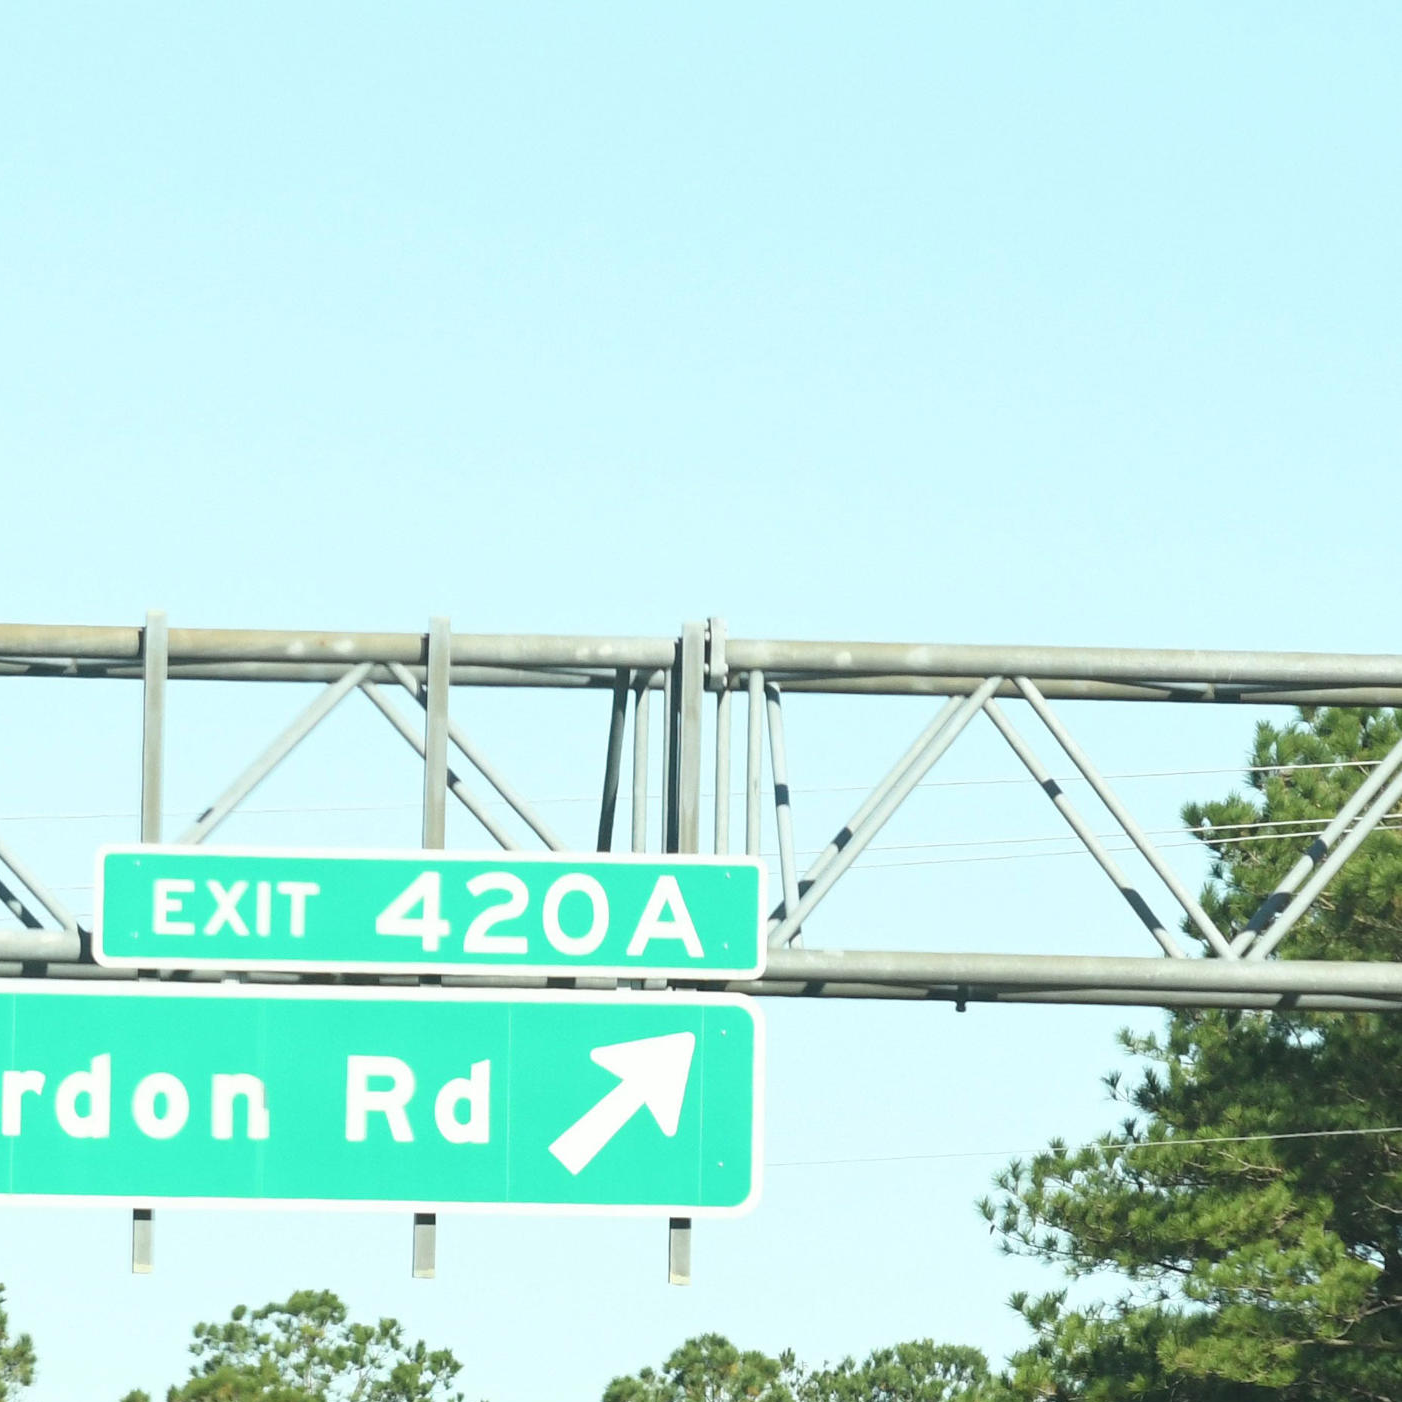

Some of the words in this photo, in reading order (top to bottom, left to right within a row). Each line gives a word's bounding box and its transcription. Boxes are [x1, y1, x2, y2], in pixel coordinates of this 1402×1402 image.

[153, 879, 319, 937] EXIT
[376, 872, 705, 959] 420A
[346, 1056, 490, 1143] Rd
